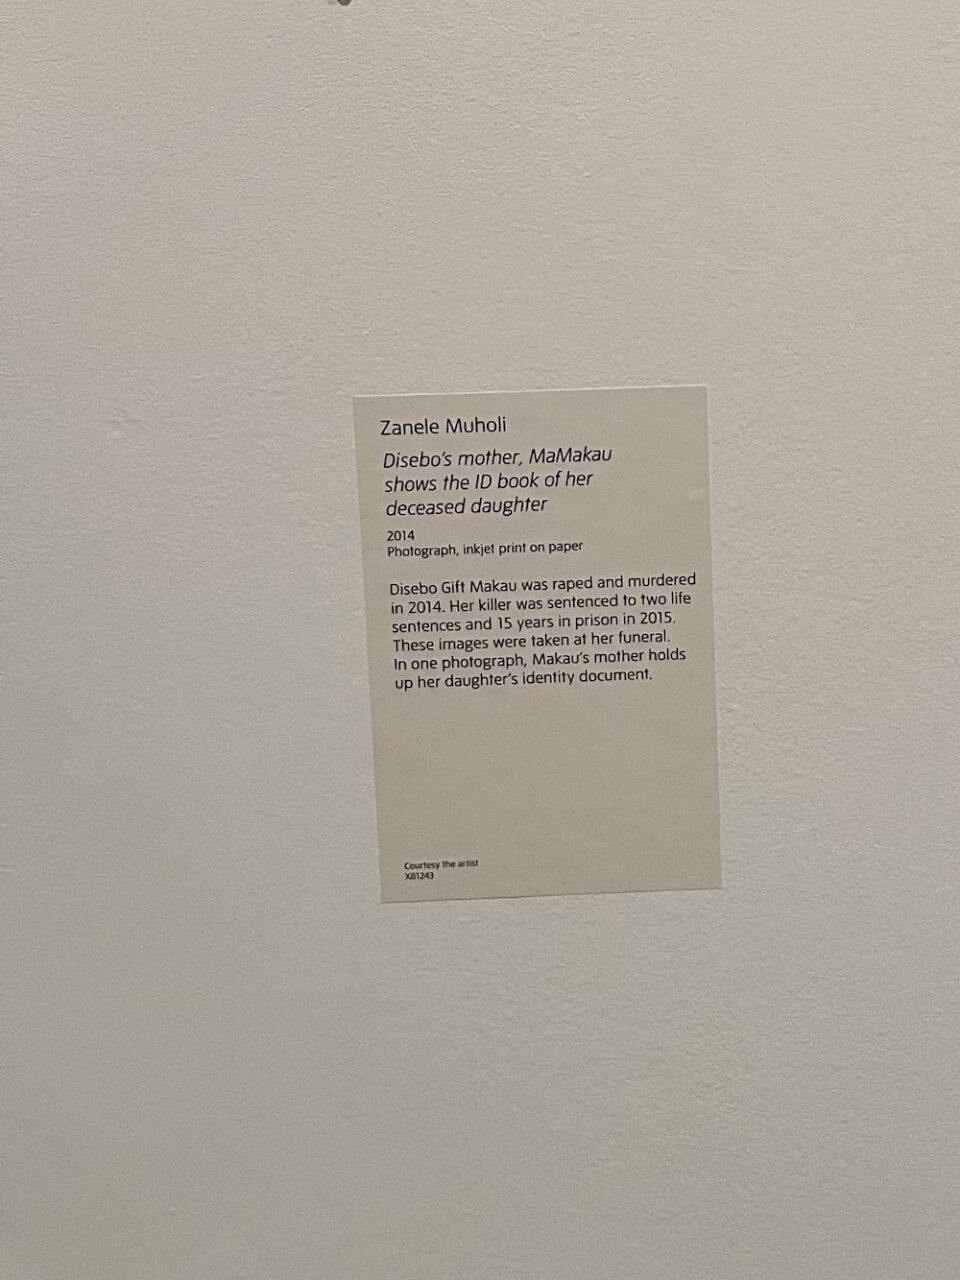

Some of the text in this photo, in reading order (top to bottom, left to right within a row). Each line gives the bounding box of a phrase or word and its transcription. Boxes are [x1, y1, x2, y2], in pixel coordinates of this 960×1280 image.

[380, 416, 507, 436] Zanele Muholi
[458, 449, 522, 466] mother,
[529, 446, 612, 463] MaMakau
[385, 470, 593, 492] shows the ID book of her
[386, 496, 547, 518] deceased daughter
[387, 531, 415, 542] 2014
[387, 541, 583, 560] Photograph, inkjet print on paper
[390, 572, 696, 595] Disebo Gift Makau was raped and murdered
[391, 592, 691, 614] in 2014. Her killer was sentenced to two life
[392, 619, 461, 632] sentences
[465, 618, 492, 630] and
[498, 617, 512, 629] 15
[517, 619, 553, 632] years
[558, 615, 571, 627] in
[575, 613, 618, 630] prison
[623, 613, 636, 625] in
[393, 630, 670, 654] These images were taken at her funeral.
[394, 657, 407, 670] In
[411, 660, 438, 669] one
[442, 653, 528, 672] photograph,
[594, 649, 645, 663] mother
[648, 648, 686, 661] holds
[395, 679, 413, 692] up
[417, 675, 441, 688] her
[522, 670, 574, 688] identity
[579, 667, 653, 682] document.
[404, 859, 479, 871] Courtesy the artist
